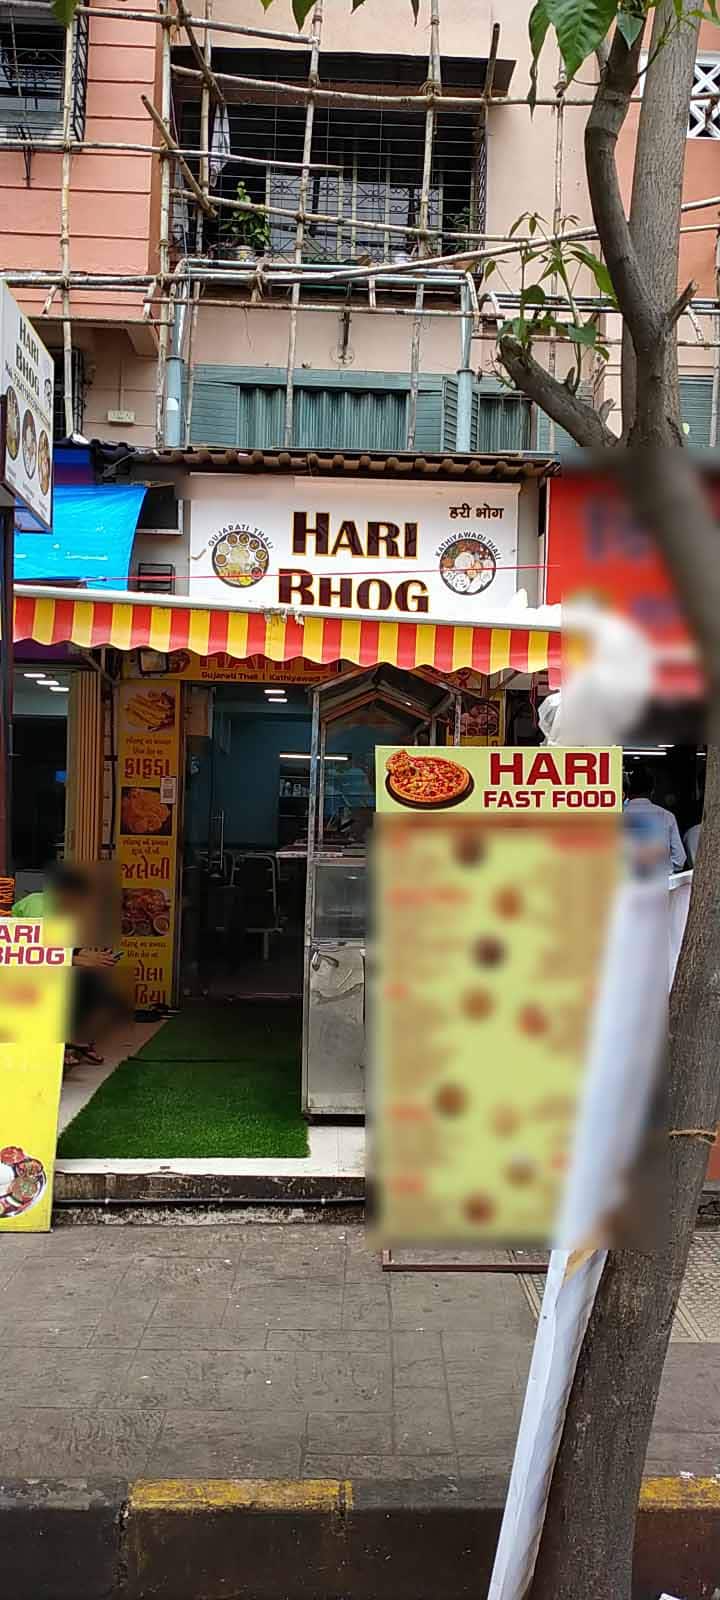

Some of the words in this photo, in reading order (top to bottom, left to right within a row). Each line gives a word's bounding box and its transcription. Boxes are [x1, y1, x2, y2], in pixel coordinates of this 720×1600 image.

[19, 316, 39, 367] HARI
[16, 343, 40, 397] BHOG
[449, 503, 472, 519] हरी
[476, 503, 504, 519] भोग
[208, 524, 250, 547] GUJARATI
[254, 527, 275, 550] THALI
[291, 510, 418, 559] HARI
[435, 531, 486, 557] KATHIYAWADI
[487, 540, 502, 560] THALI
[278, 567, 429, 613] BHOG
[201, 671, 237, 681] Gujarati
[490, 752, 610, 785] HARI
[483, 790, 546, 808] FAST
[552, 790, 617, 808] FOOD
[0, 925, 40, 943] ARI
[0, 947, 65, 964] HOG
